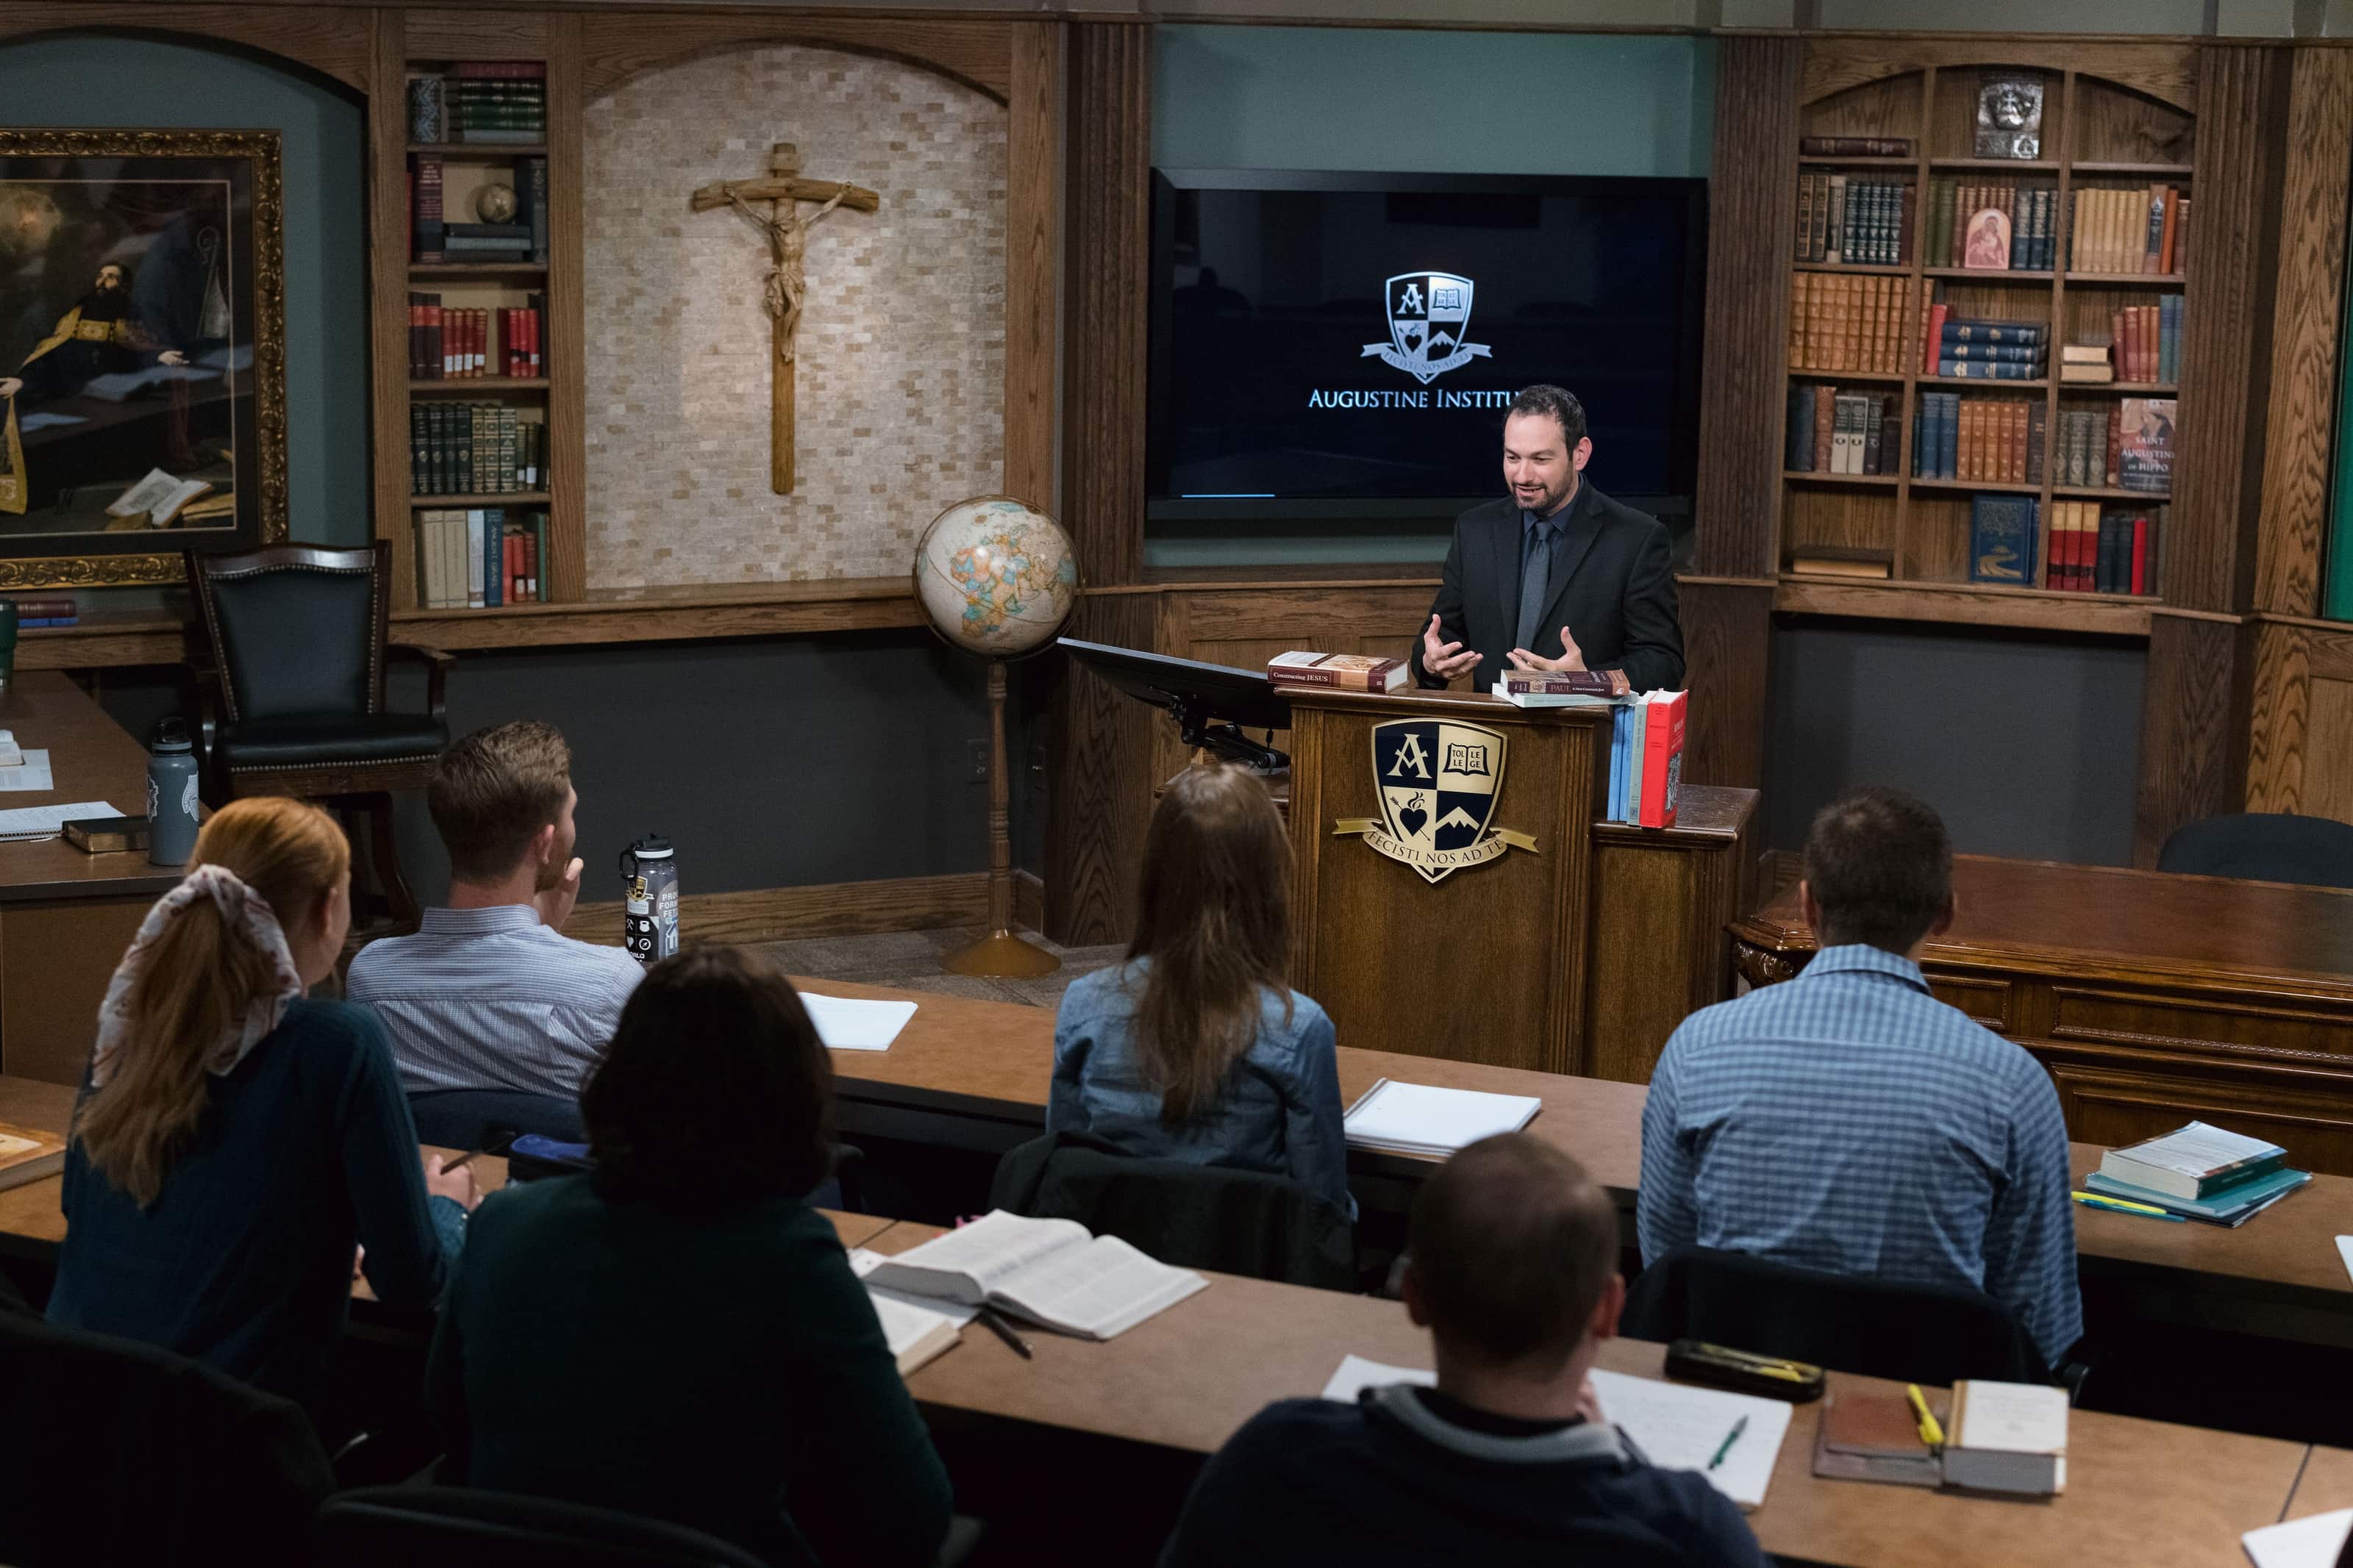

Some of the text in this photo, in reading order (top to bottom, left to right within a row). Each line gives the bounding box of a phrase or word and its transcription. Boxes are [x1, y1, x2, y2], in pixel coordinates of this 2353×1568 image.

[1436, 389, 1519, 408] INSTITU
[2135, 437, 2165, 445] SAINT
[2138, 462, 2168, 472] HIPPO
[1273, 672, 1328, 682] Constructing JESUS
[1551, 684, 1571, 692] PAUL
[1386, 733, 1433, 779] A
[1452, 749, 1465, 758] TOL
[1454, 759, 1463, 767] LE
[1368, 832, 1504, 864] FECISTI NOS AD TE
[662, 892, 677, 901] PRO
